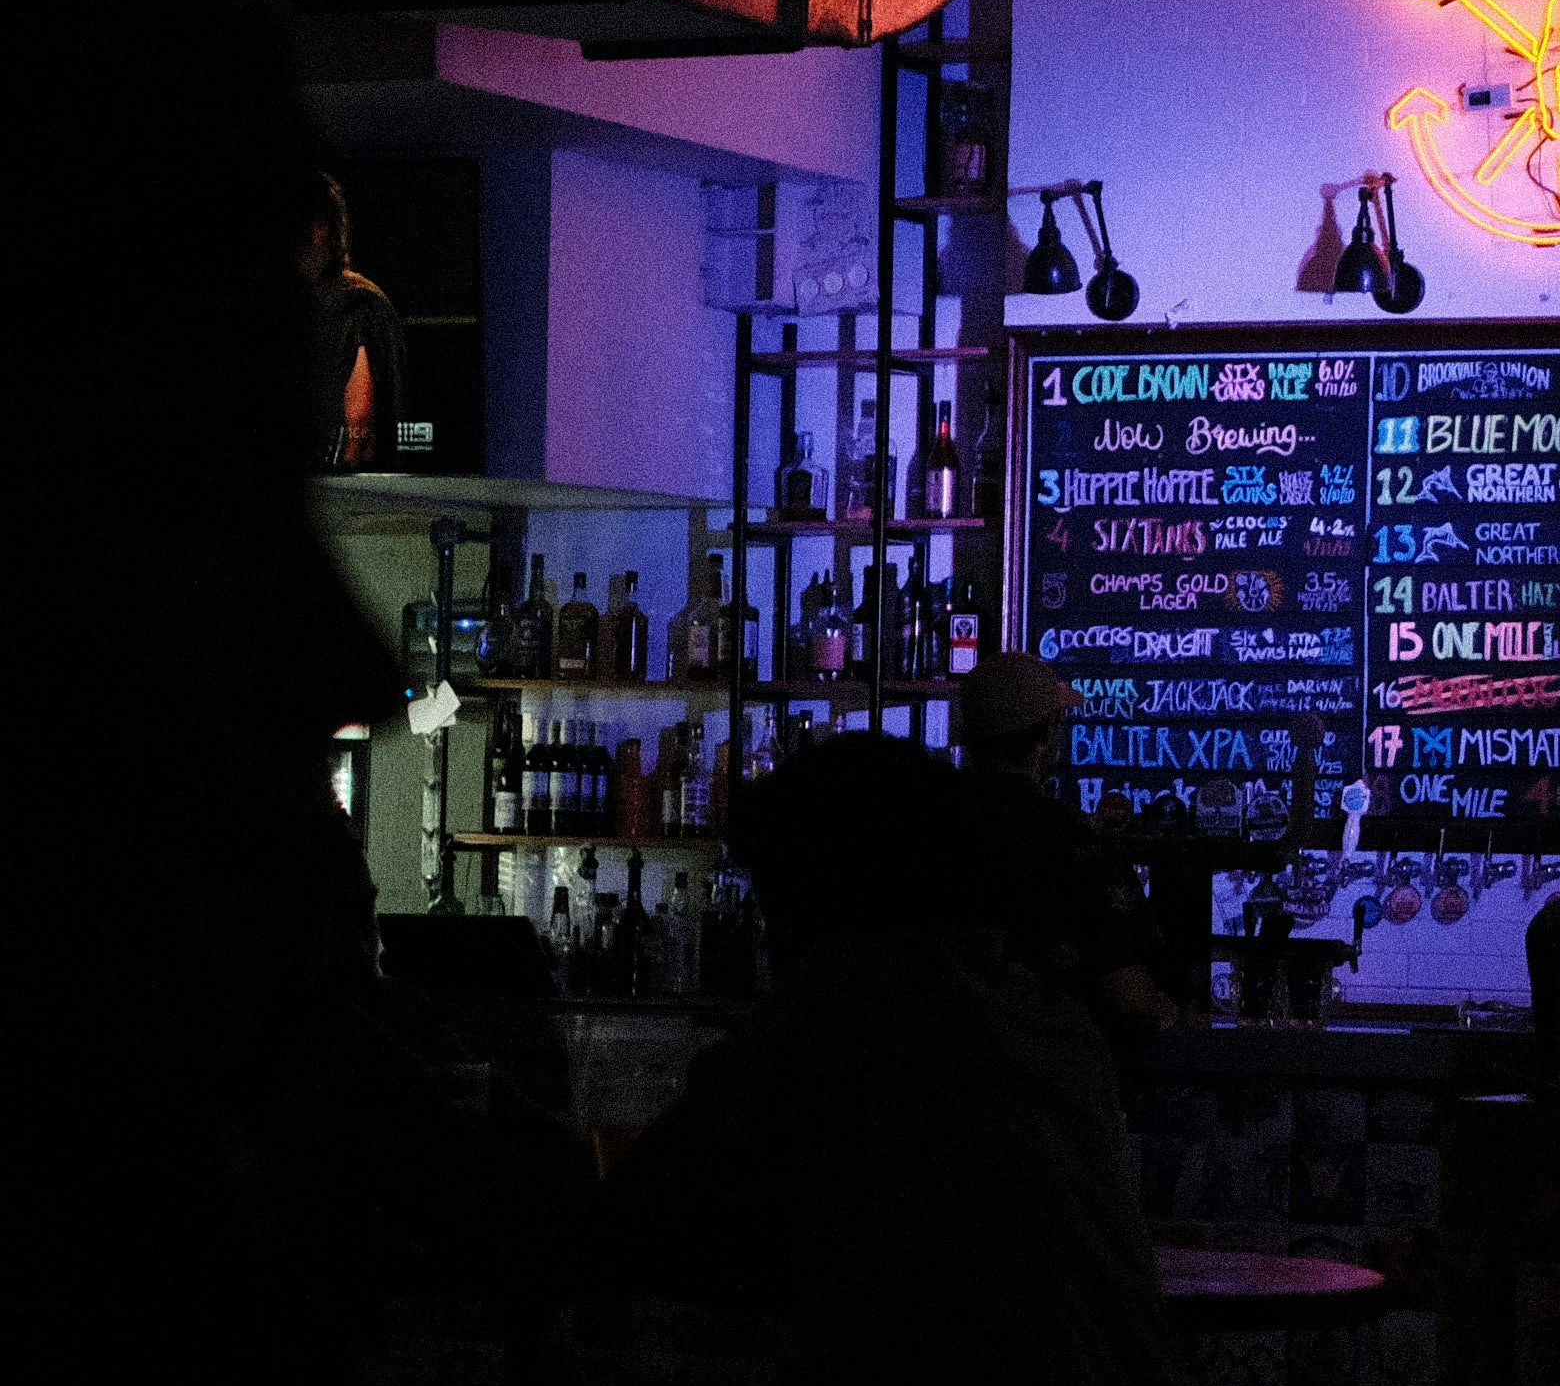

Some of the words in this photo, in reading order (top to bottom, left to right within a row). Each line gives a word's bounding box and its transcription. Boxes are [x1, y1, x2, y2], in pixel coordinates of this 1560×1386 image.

[1042, 367, 1068, 406] 1
[1139, 364, 1209, 402] BROWN
[1271, 379, 1309, 400] ALE
[1374, 363, 1411, 401] 10
[1418, 361, 1481, 392] BROOKVALE
[1500, 361, 1550, 390] UNION
[1374, 415, 1420, 454] 11
[1426, 414, 1507, 453] BLUE
[1037, 469, 1060, 506] 3
[1063, 468, 1140, 507] HIPPIE
[1143, 468, 1220, 506] HOPPIE
[1375, 466, 1416, 506] 12
[1466, 463, 1557, 485] GREAT
[1468, 483, 1555, 503] NORTHERN
[1047, 518, 1071, 553] 4
[1091, 517, 1137, 554] SIX
[1138, 517, 1207, 556] TANKS
[1215, 532, 1246, 549] PALE
[1258, 530, 1285, 547] ALE
[1372, 524, 1418, 563] 13
[1475, 523, 1541, 541] GREAT
[1089, 572, 1163, 595] CHAMPS
[1176, 572, 1229, 594] GOLD
[1373, 575, 1413, 614] 14
[1422, 579, 1513, 612] BALTER
[1139, 592, 1198, 611] LAGER
[1039, 628, 1060, 659] 6
[1060, 625, 1134, 650] DOCTORS
[1134, 628, 1220, 659] DRAUGHT
[1389, 622, 1424, 661] 15
[1432, 621, 1483, 660] ONE
[1484, 620, 1544, 661] MILE
[1287, 679, 1342, 695] DARWIN
[1372, 680, 1402, 709] 16
[1071, 724, 1181, 770] BALTER
[1187, 727, 1254, 771] XPA
[1368, 725, 1403, 768] 17
[1399, 774, 1456, 804] ONE
[1451, 787, 1509, 819] MILE
